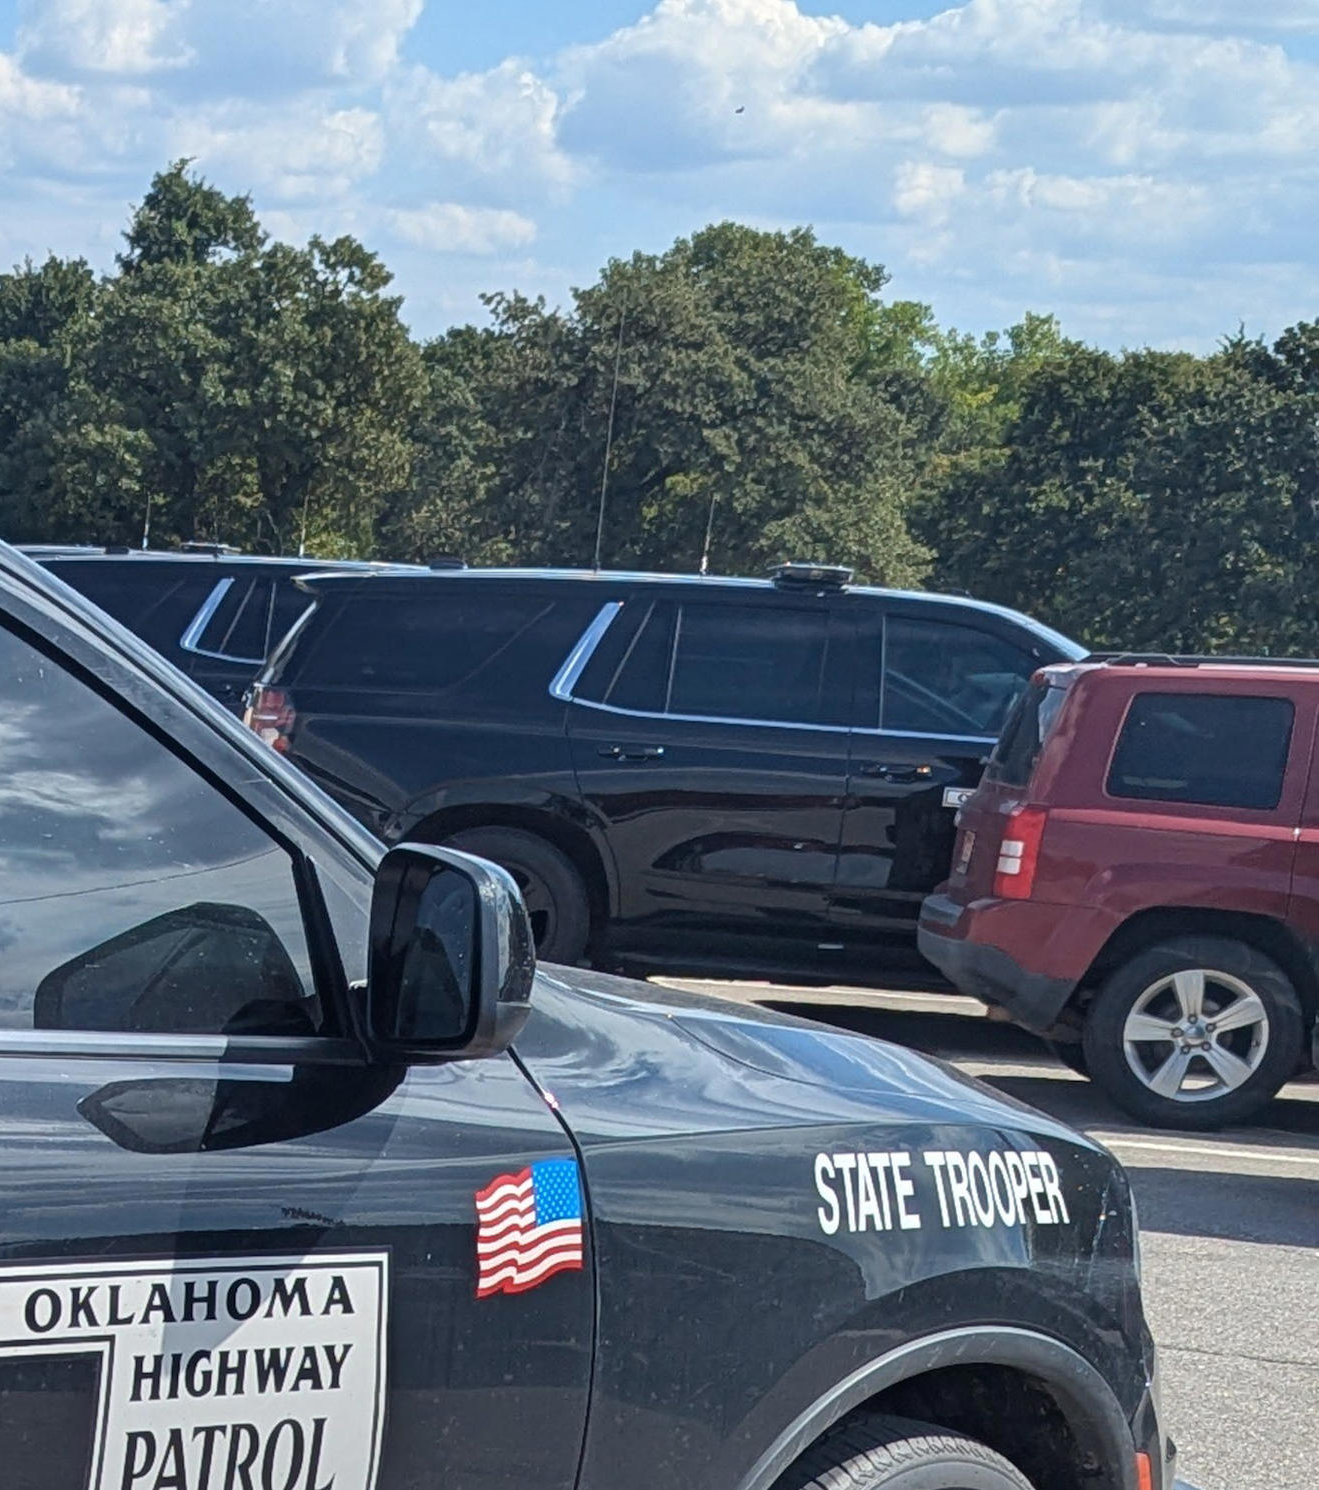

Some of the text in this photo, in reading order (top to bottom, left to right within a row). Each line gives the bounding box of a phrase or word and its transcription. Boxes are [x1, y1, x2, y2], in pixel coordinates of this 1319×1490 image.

[814, 1150, 1070, 1236] STATE TROOPER
[23, 1275, 355, 1333] OKLAHOMA
[128, 1343, 353, 1402] HIGHWAY
